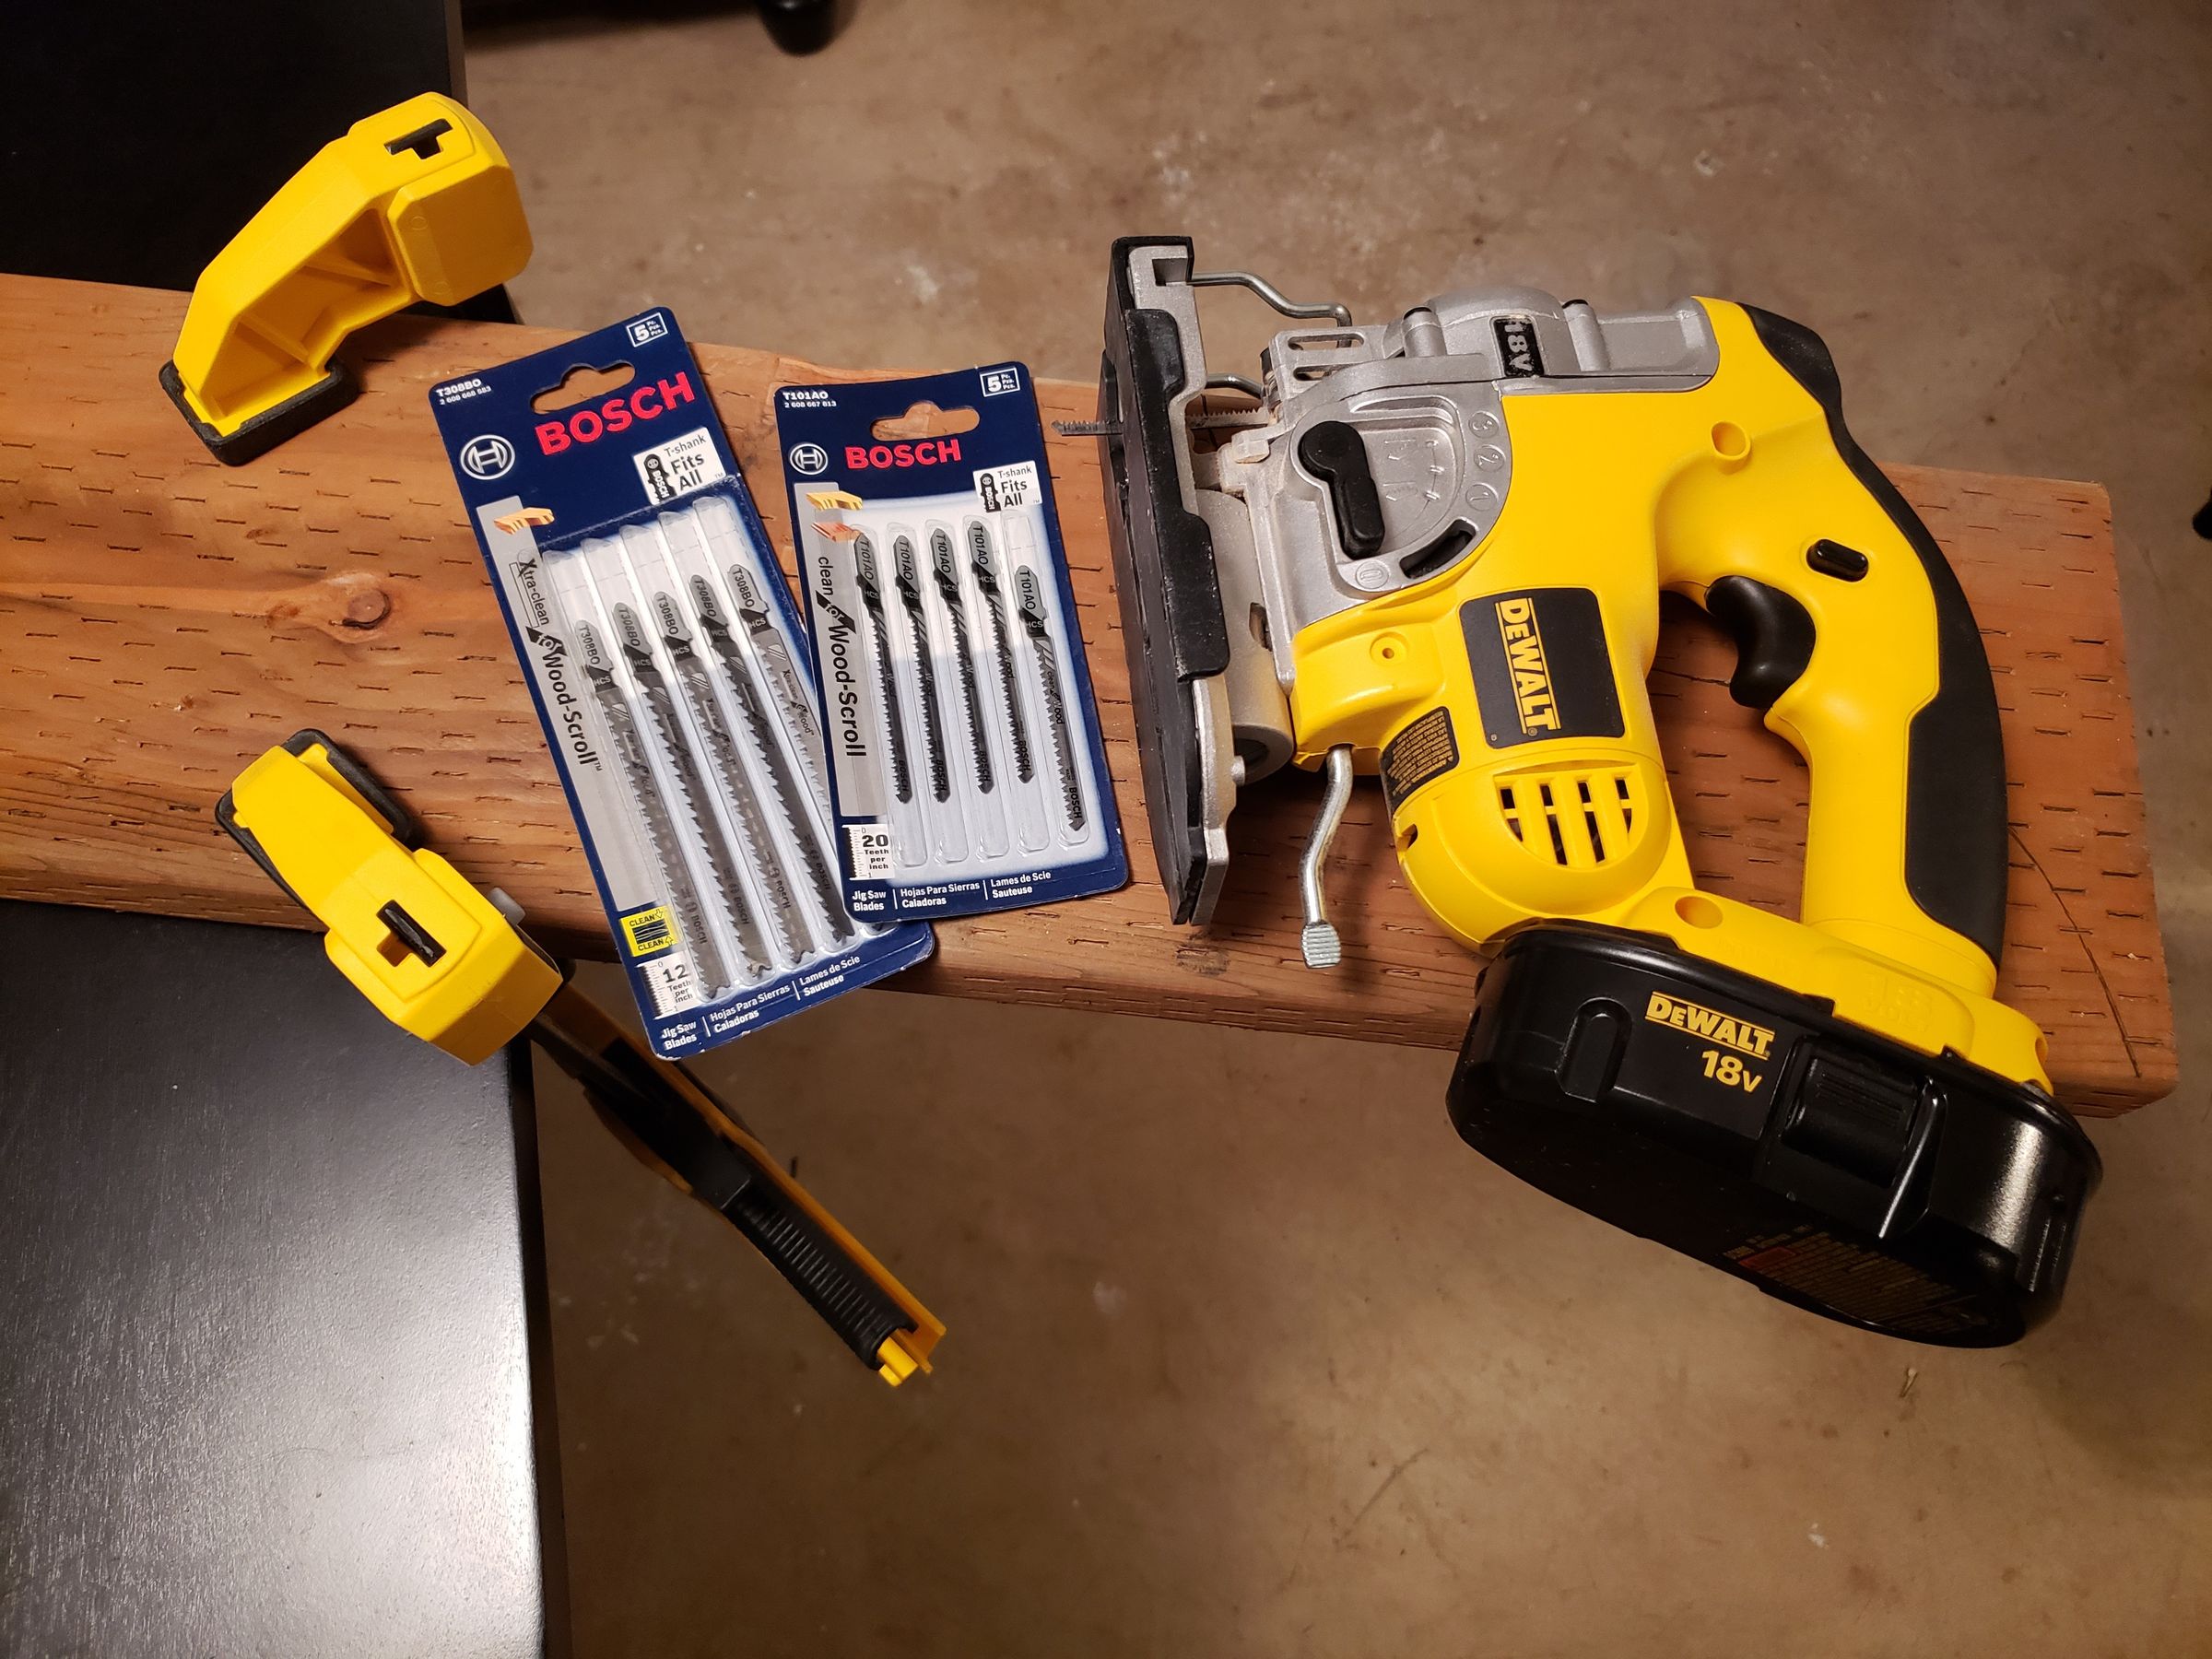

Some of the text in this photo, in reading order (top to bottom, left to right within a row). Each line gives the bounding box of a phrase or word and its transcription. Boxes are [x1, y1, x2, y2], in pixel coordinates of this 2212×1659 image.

[634, 324, 650, 341] 5
[436, 378, 482, 397] T308BO
[987, 375, 1002, 392] 5
[782, 391, 829, 400] T101AO
[535, 371, 695, 455] BOSCH
[665, 435, 706, 457] T-shank
[844, 439, 961, 470] BOSCH
[671, 453, 704, 475] Fits
[997, 465, 1032, 478] T-shank
[653, 470, 669, 498] BOSCH
[679, 469, 702, 491] All
[1001, 479, 1028, 493] Fits
[1005, 492, 1023, 507] All
[935, 534, 951, 573] T101AO
[972, 525, 989, 565] T101AO
[860, 541, 874, 580] T101AO
[899, 541, 913, 581] T101AO
[519, 559, 549, 626] Xtra-clean
[695, 579, 716, 618] T308BO
[733, 569, 755, 607] T308BO
[1019, 570, 1036, 610] T101AO
[657, 595, 678, 635] T308BO
[618, 607, 641, 646] T308BO
[579, 625, 600, 665] T308BO
[818, 557, 834, 595] clean
[829, 626, 867, 757] Wood-Scroll
[1499, 598, 1558, 732] DEWALT
[1069, 787, 1082, 819] BOSCH
[862, 834, 888, 847] 20
[900, 882, 981, 898] Hojas Para Sierras
[991, 877, 1018, 888] Lames
[852, 890, 887, 900] Jig Saw
[901, 897, 947, 909] Caladoras
[853, 902, 885, 912] Blades
[629, 914, 655, 927] CLEAN
[638, 938, 664, 951] CLEAN
[663, 964, 688, 983] 12
[799, 969, 829, 986] Lames
[840, 955, 860, 969] Scie
[667, 980, 691, 992] Teeth
[675, 988, 689, 998] per
[803, 974, 844, 996] Sauteuse
[675, 994, 693, 1004] inch
[709, 984, 791, 1023] Hojas Para Sierras
[662, 1021, 697, 1040] Jig Saw
[713, 1009, 759, 1034] Caladoras
[1646, 994, 1775, 1056] DEWALT
[665, 1033, 697, 1051] Blades
[1701, 1049, 1763, 1094] 18V
